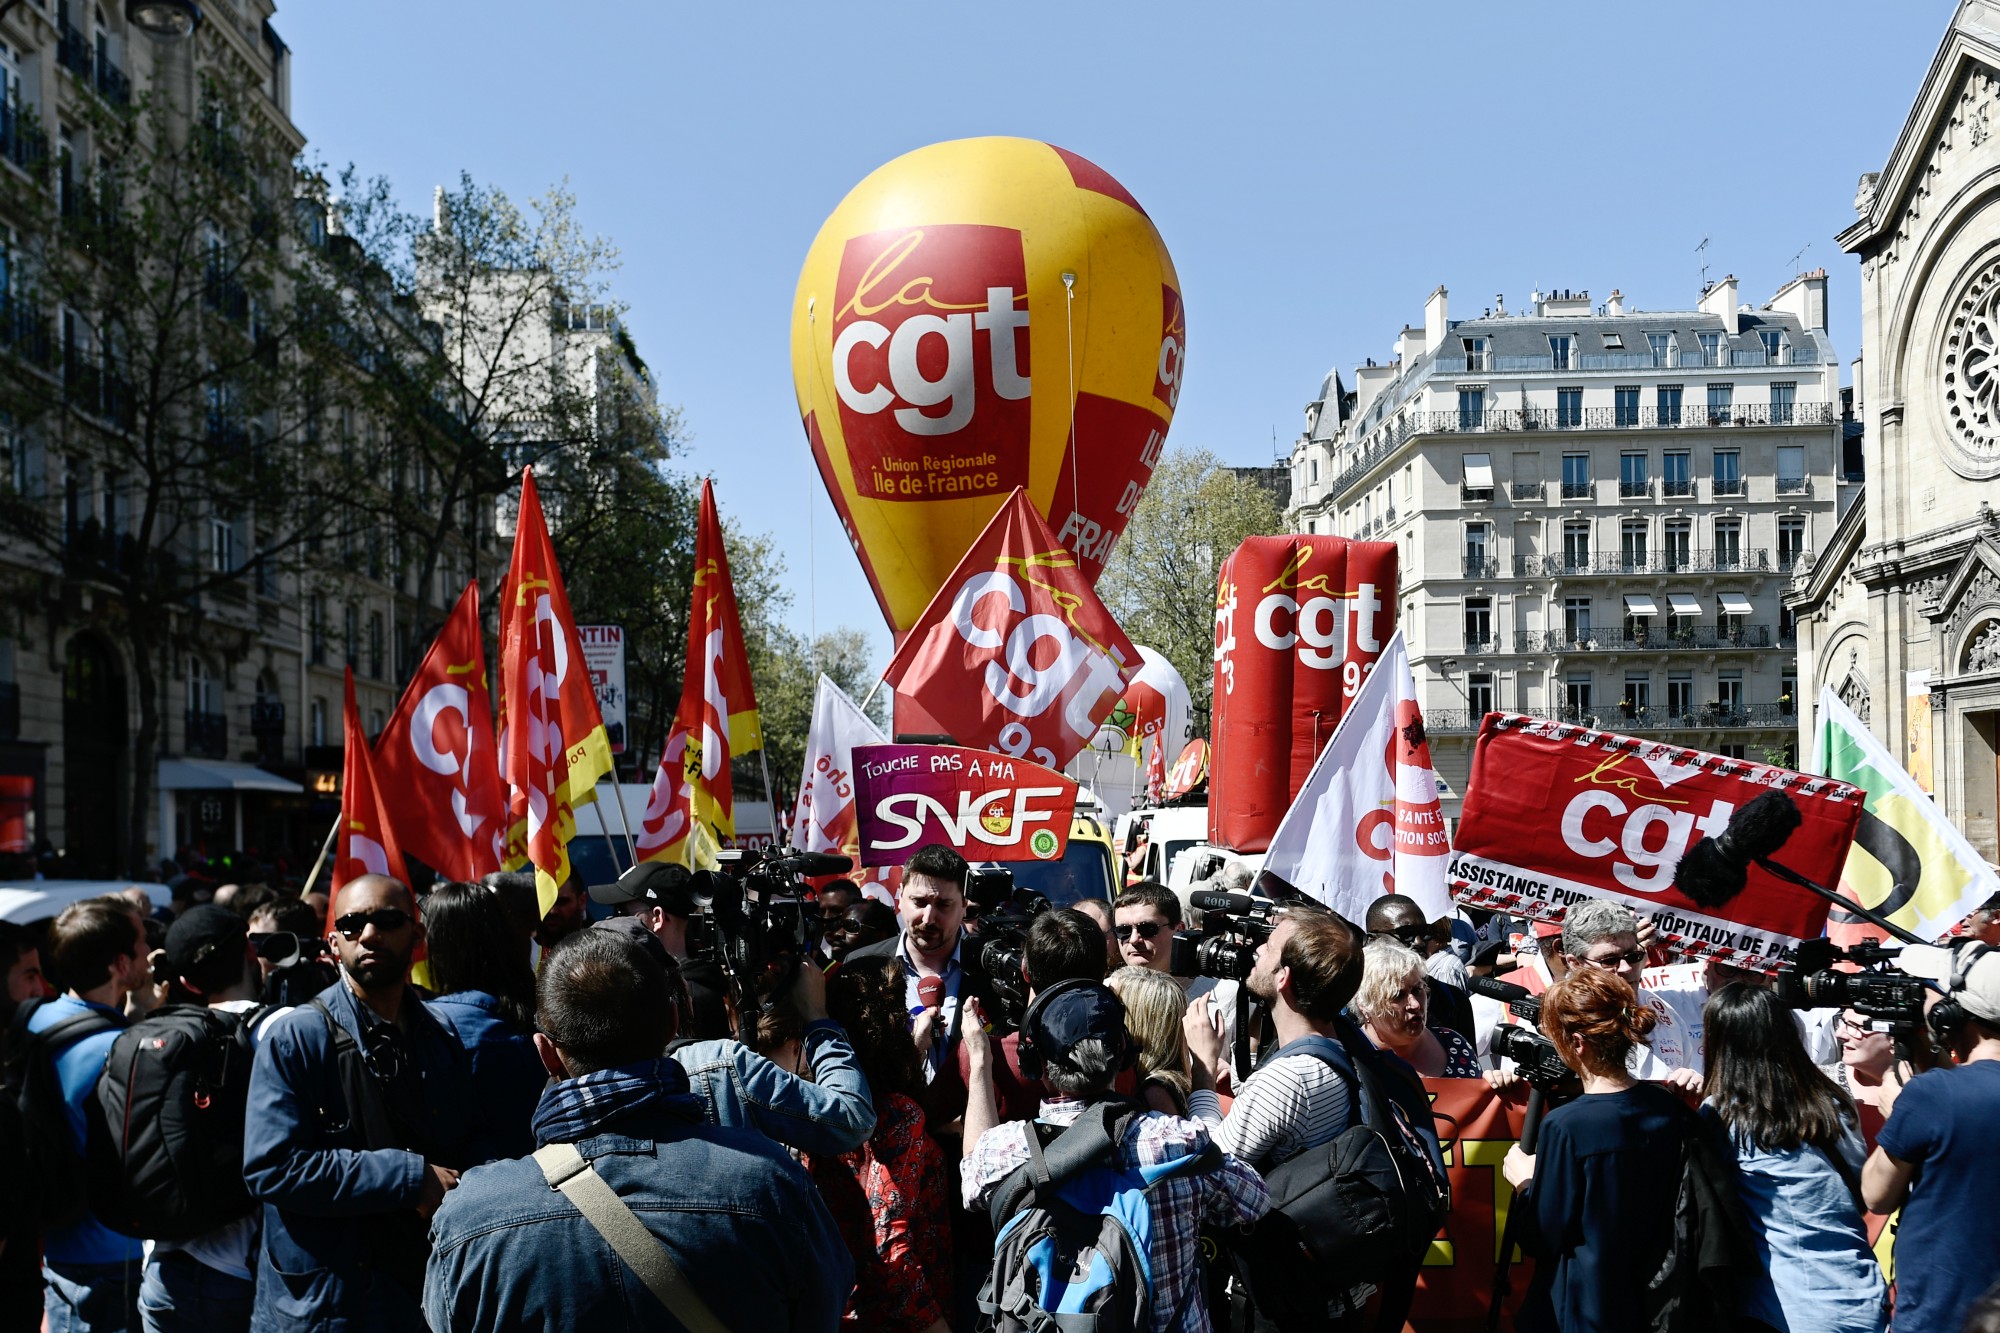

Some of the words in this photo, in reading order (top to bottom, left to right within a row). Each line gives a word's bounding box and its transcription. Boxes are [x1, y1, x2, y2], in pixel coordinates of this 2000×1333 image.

[834, 230, 988, 322] la
[832, 286, 1031, 436] cgt
[882, 457, 919, 472] Union
[923, 452, 996, 475] Régionale
[1263, 546, 1362, 597] la
[1254, 583, 1382, 670] cgt
[951, 571, 1126, 740] cgt
[861, 755, 919, 780] TOUCHE
[931, 754, 963, 773] PAS
[968, 759, 983, 778] A
[989, 761, 1015, 782] MA
[1535, 728, 1551, 738] CGT
[1557, 728, 1592, 745] HÔPITAL
[1606, 740, 1642, 754] DANGER
[1668, 752, 1702, 768] HÔPITAL
[1718, 763, 1753, 779] DANGER
[1757, 777, 1773, 785] CGT
[1781, 777, 1816, 793] HÔPITAL
[870, 786, 1064, 850] SNCF
[988, 806, 1005, 818] cgt
[1398, 808, 1436, 825] SANTÉ
[1448, 859, 1549, 901] ASSISTANCE
[1487, 894, 1521, 908] DANGER
[1204, 896, 1232, 909] RØDE
[1650, 911, 1738, 949] HÔPITAUX
[1738, 935, 1764, 955] DE
[1479, 978, 1506, 991] RØDE
